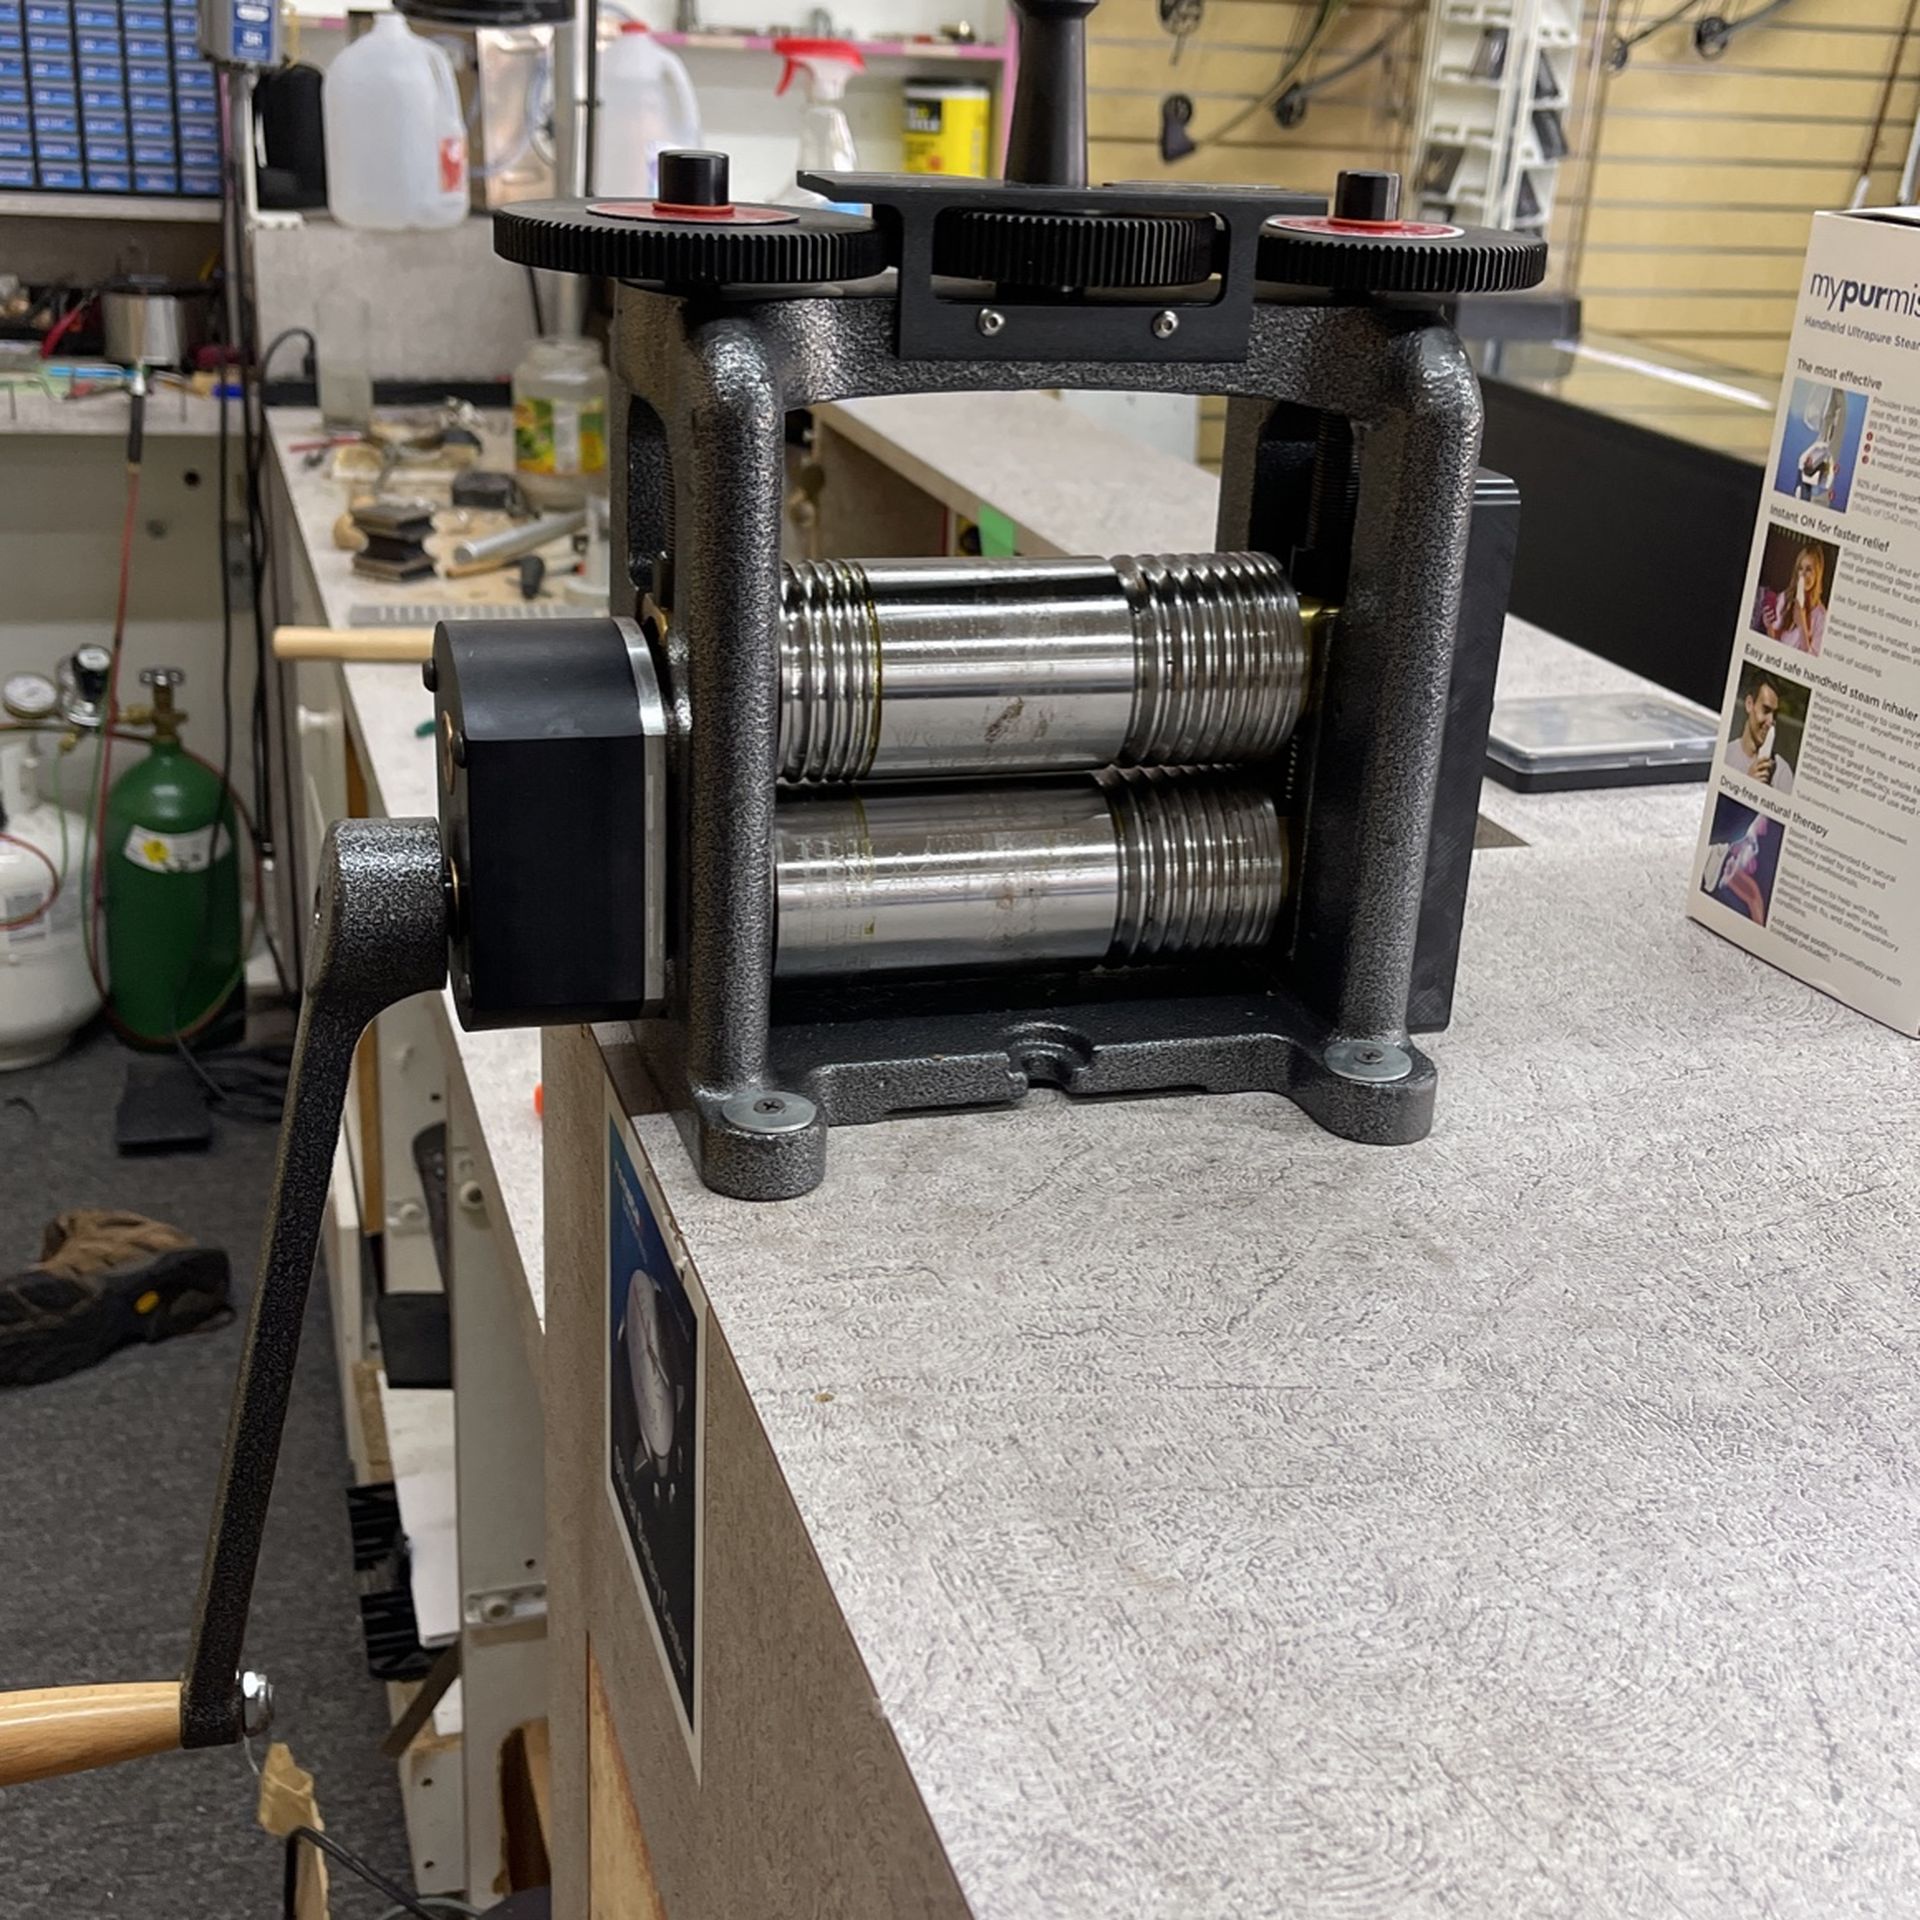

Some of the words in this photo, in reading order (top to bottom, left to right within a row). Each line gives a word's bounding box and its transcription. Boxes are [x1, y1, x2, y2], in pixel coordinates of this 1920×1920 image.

[1804, 316, 1846, 335] Handheld
[1847, 324, 1892, 345] Ultrapure
[1797, 358, 1813, 373] The
[1814, 365, 1838, 380] most
[1840, 370, 1883, 390] effective
[1769, 504, 1799, 524] Instant
[1800, 515, 1817, 529] ON
[1817, 520, 1833, 535] for
[1833, 525, 1861, 544] faster
[1863, 537, 1890, 552] relief
[1855, 565, 1894, 585] penetrating
[1885, 611, 1912, 629] minutes
[1871, 643, 1890, 655] other
[1891, 649, 1912, 662] steam
[1744, 643, 1764, 663] Easy
[1764, 654, 1782, 669] and
[1783, 660, 1803, 676] safe
[1803, 669, 1849, 695] handheld
[1850, 687, 1881, 708] steam
[1881, 699, 1919, 722] inhaler
[1862, 711, 1878, 724] easy
[1835, 765, 1862, 781] superior
[1846, 760, 1864, 773] great
[1890, 778, 1911, 791] whole
[1898, 759, 1915, 770] work
[1720, 775, 1759, 803] Drug-free
[1760, 796, 1791, 819] natural
[1792, 811, 1829, 838] therapy
[1815, 841, 1861, 867] recommended
[1872, 868, 1896, 883] natural
[1820, 854, 1836, 867] relief
[1846, 866, 1871, 883] doctors
[1807, 881, 1829, 895] proven
[1812, 894, 1846, 915] associated
[1862, 929, 1899, 952] respiratory
[1810, 937, 1838, 957] soothing
[1839, 952, 1885, 980] aromatherapy
